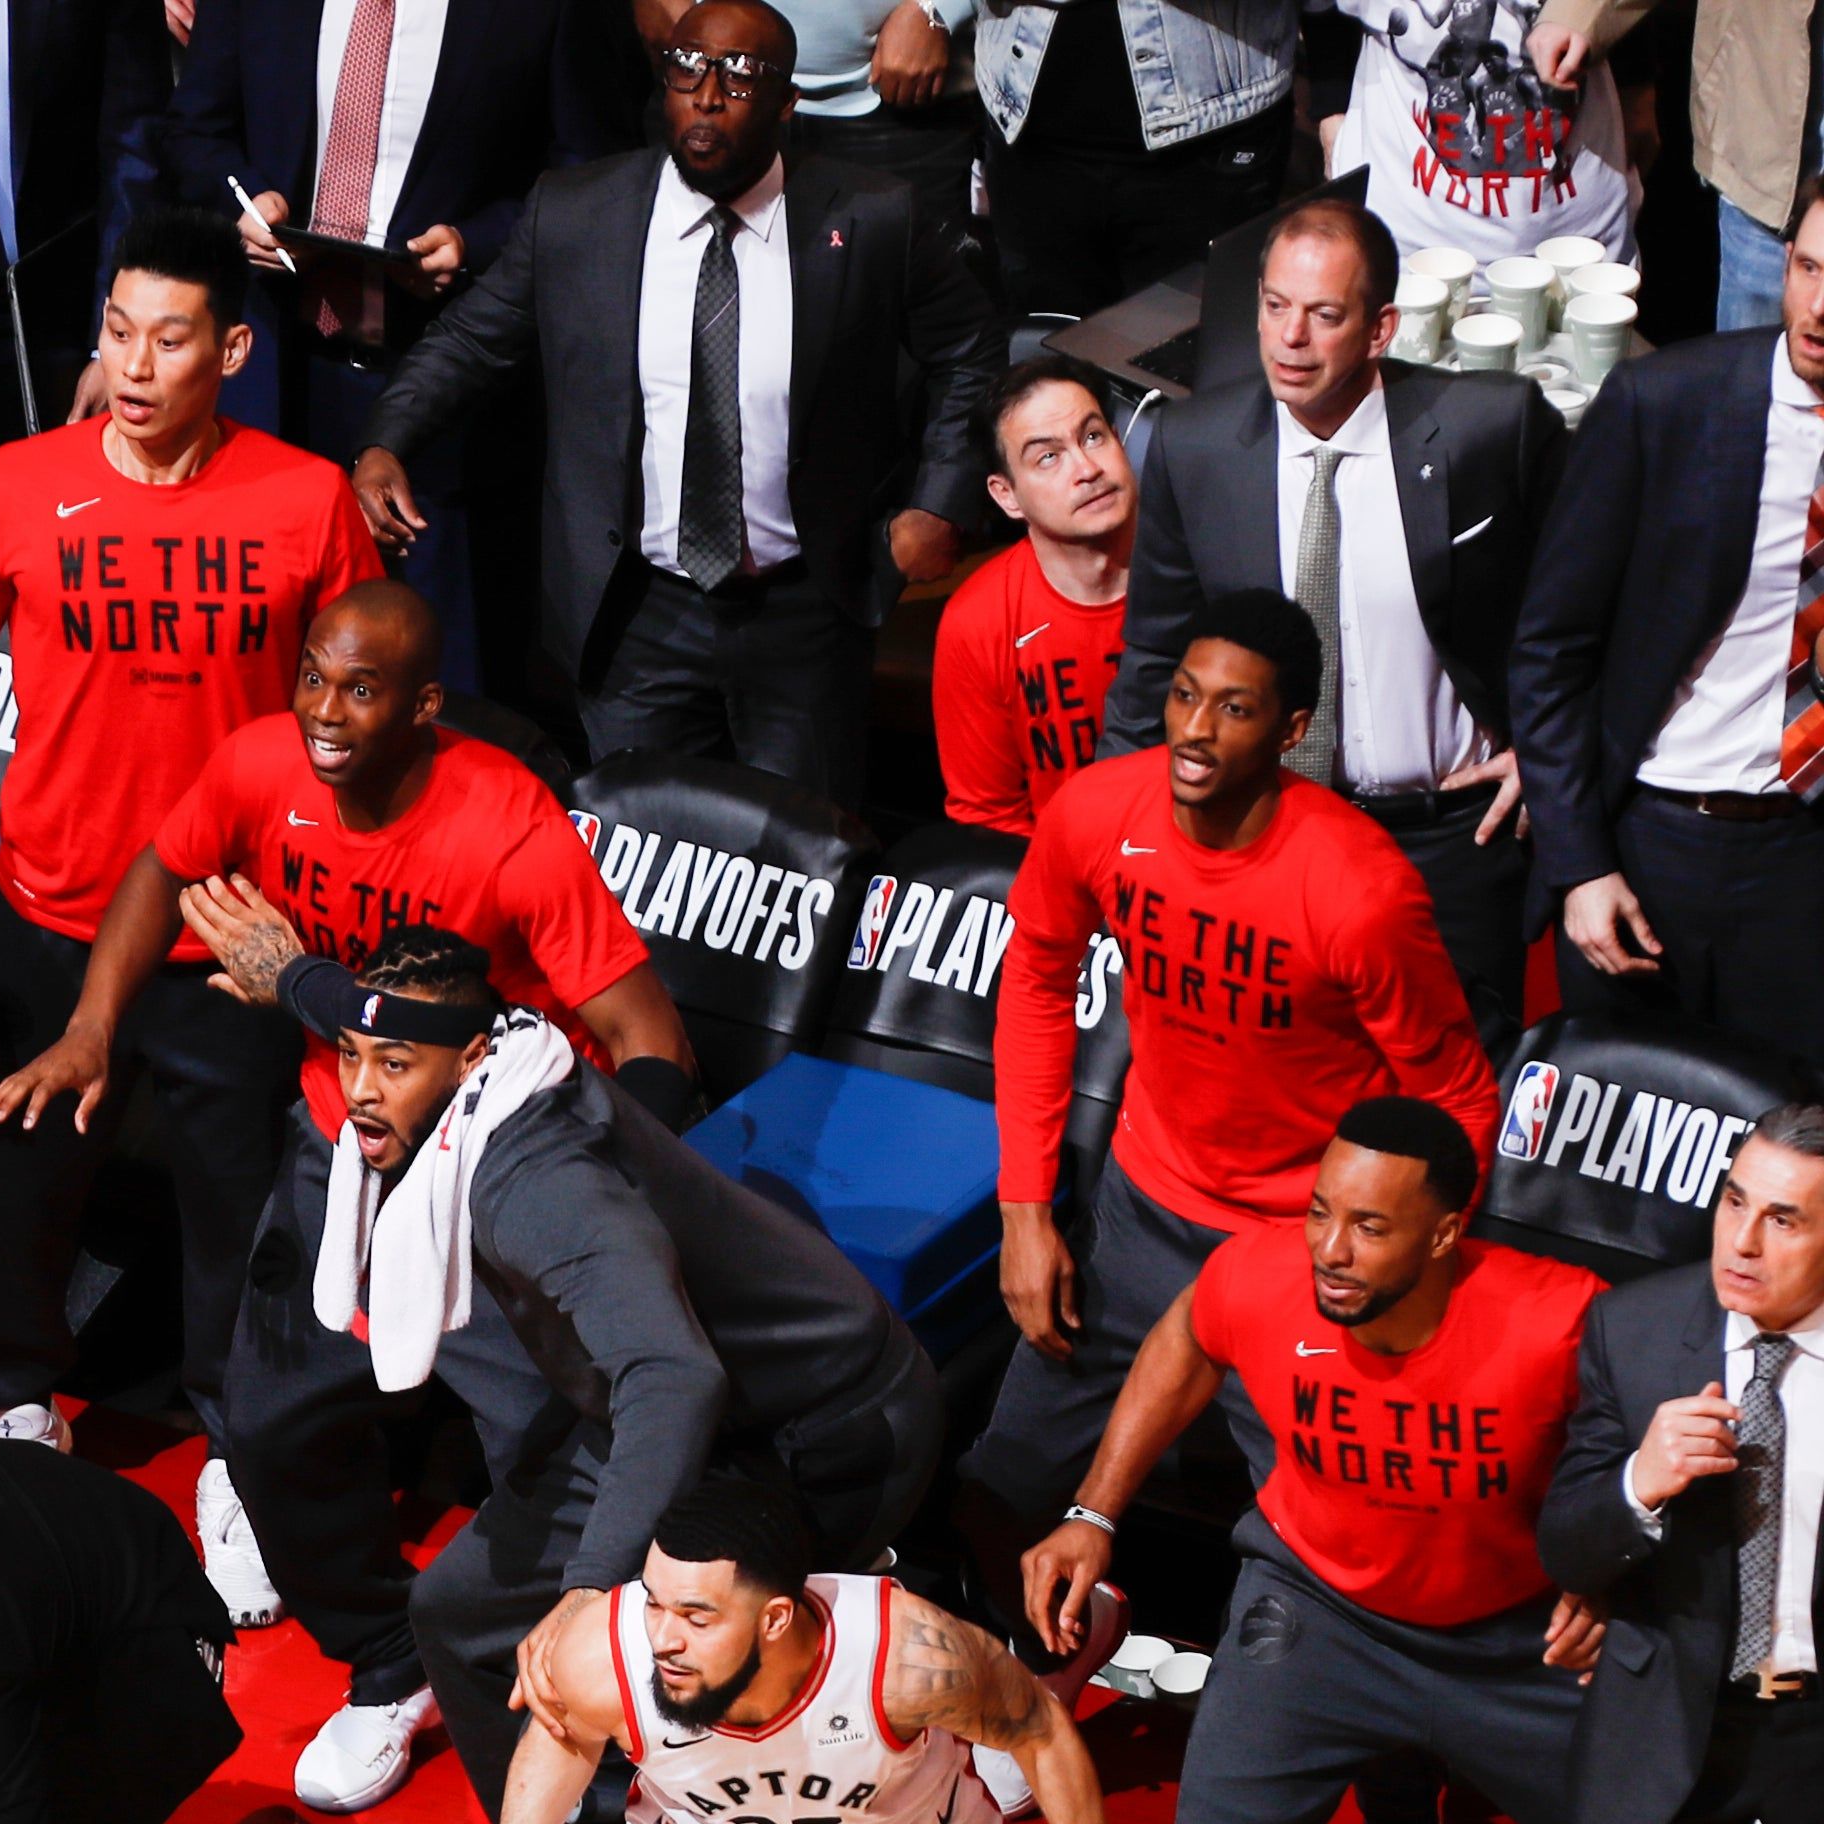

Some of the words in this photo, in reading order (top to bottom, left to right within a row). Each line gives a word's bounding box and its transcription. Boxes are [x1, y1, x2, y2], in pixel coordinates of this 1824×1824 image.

[1413, 99, 1462, 160] WE
[57, 536, 127, 593] WE
[152, 536, 267, 595] THE
[60, 600, 269, 656] NORTH
[1017, 658, 1084, 717] WE
[282, 842, 331, 915] WE
[600, 823, 836, 971] PLAYOFFS
[876, 881, 1124, 1030] PLAYS
[1115, 872, 1165, 943] WE
[1189, 908, 1292, 987] THE
[1543, 1073, 1756, 1209] PLAYOF
[1293, 1374, 1357, 1434] WE
[1384, 1401, 1504, 1454] THE
[1292, 1430, 1509, 1499] NORTH
[818, 1736, 842, 1747] Sun
[843, 1731, 866, 1743] Life
[686, 1771, 880, 1816] APTOR
